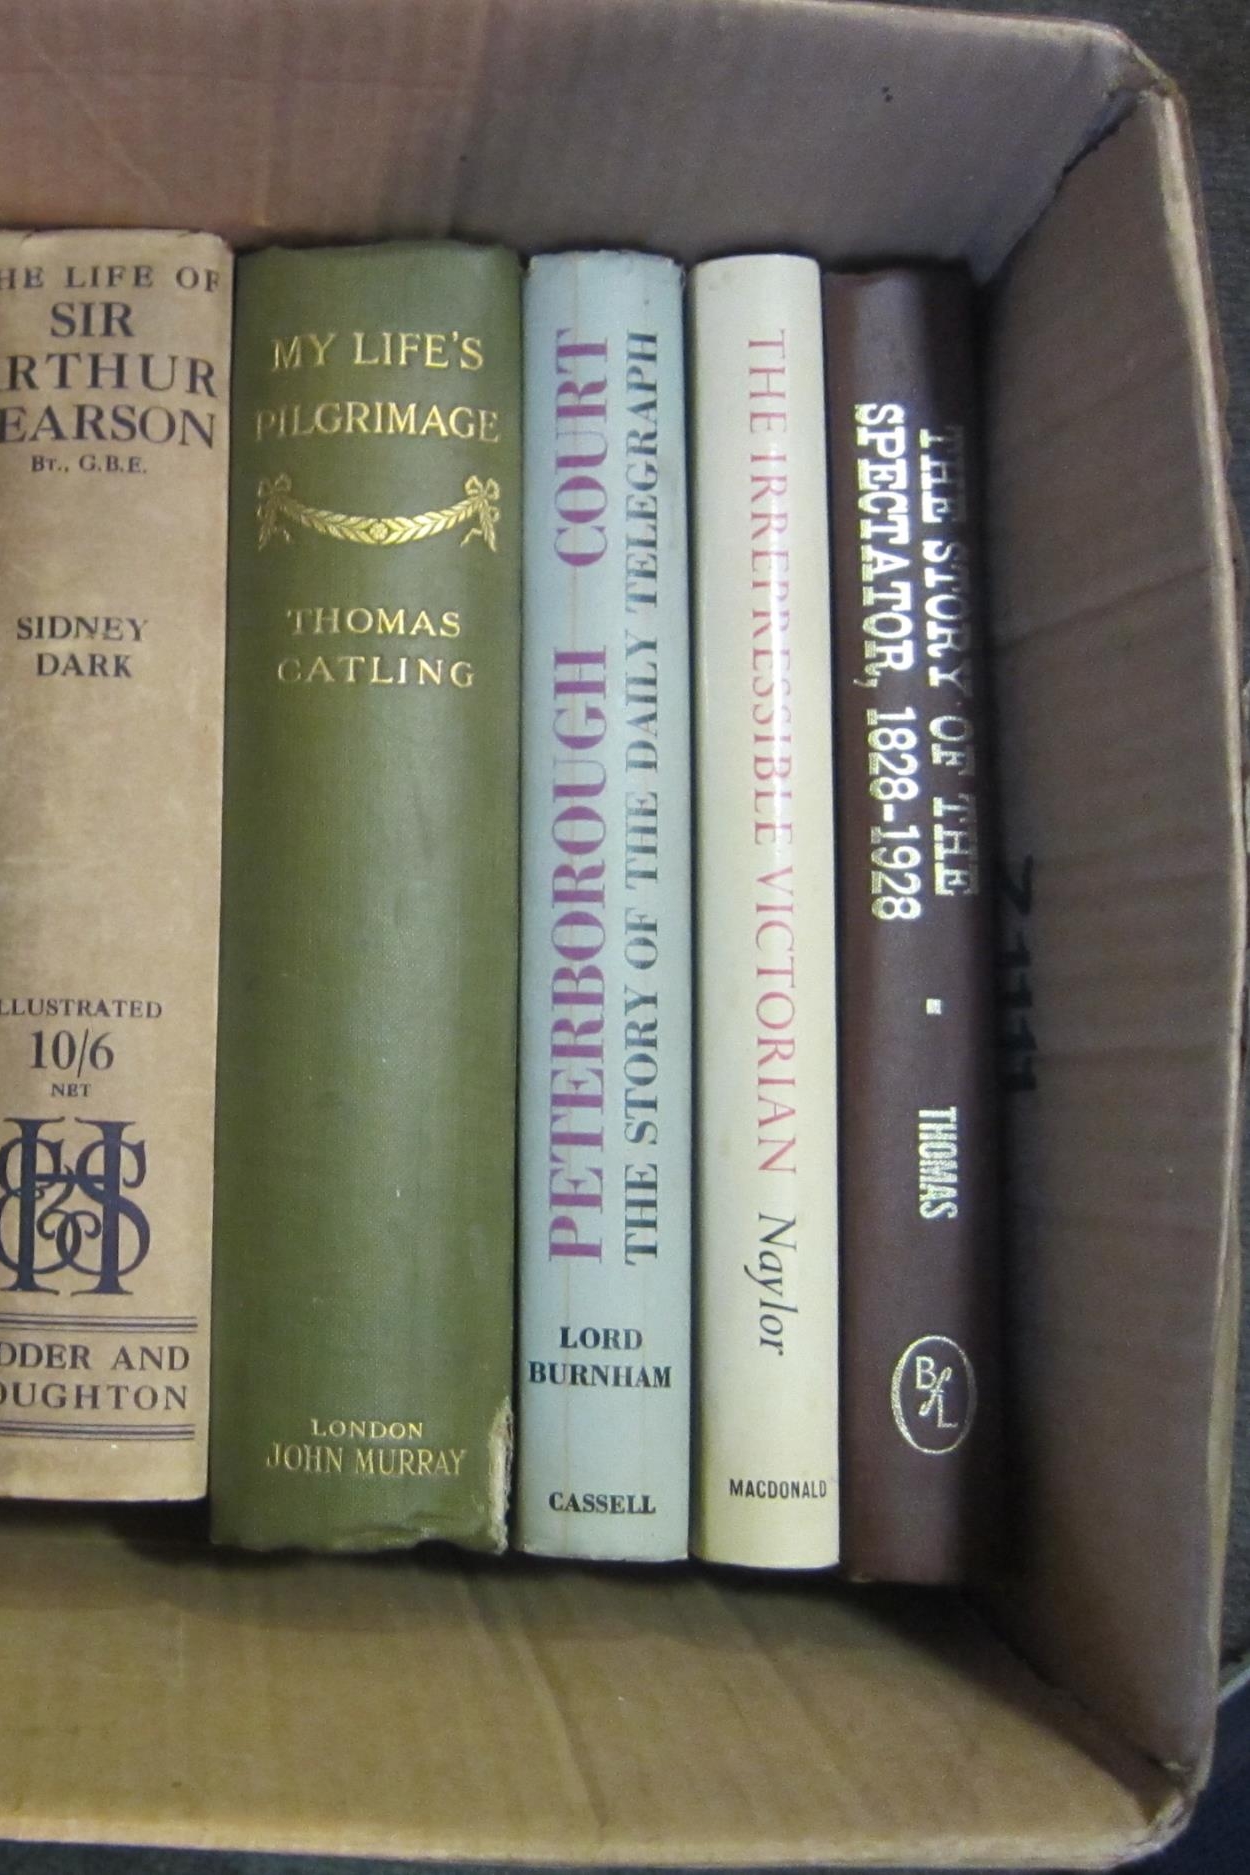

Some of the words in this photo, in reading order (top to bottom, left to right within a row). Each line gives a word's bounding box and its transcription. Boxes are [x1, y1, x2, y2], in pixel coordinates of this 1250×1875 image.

[65, 266, 153, 289] LIFE
[175, 267, 221, 292] OF
[49, 302, 135, 338] SIR
[272, 334, 336, 371] MY
[353, 331, 485, 371] LIFE'S
[747, 329, 788, 435] THE
[256, 402, 501, 444] PILGRIMAGE
[552, 328, 609, 567] COURT
[625, 331, 659, 609] TELEGRAPH
[920, 424, 966, 522] THE
[854, 403, 914, 688] SPECTATOR,
[17, 617, 149, 642] SIDNEY
[287, 608, 462, 638] THOMAS
[749, 452, 793, 846] IRREPRESSIBLE
[922, 540, 973, 698] STORY
[36, 653, 132, 679] DARK
[277, 658, 475, 688] CATLING
[625, 632, 659, 774] DAILY
[930, 713, 976, 776] OF
[625, 793, 659, 888] THE
[867, 706, 922, 920] 1828-1928
[933, 792, 980, 896] THE
[550, 645, 608, 1263] PETERBOROUGH
[625, 907, 659, 971] OF
[753, 865, 797, 1175] VICTORIAN
[29, 1027, 115, 1078] 10/6
[625, 986, 659, 1145] STORY
[50, 1082, 91, 1098] NET
[919, 1106, 958, 1219] THOMAS
[625, 1164, 659, 1266] THE
[743, 1211, 798, 1356] Naylor
[111, 1345, 190, 1371] AND
[559, 1326, 643, 1351] LORD
[528, 1361, 672, 1389] BURNHAM
[266, 1443, 343, 1475] JOHN
[355, 1447, 467, 1477] MURRAY
[311, 1419, 424, 1440] LONDON
[548, 1491, 657, 1516] CASSELL
[728, 1478, 828, 1500] MACDONALD
